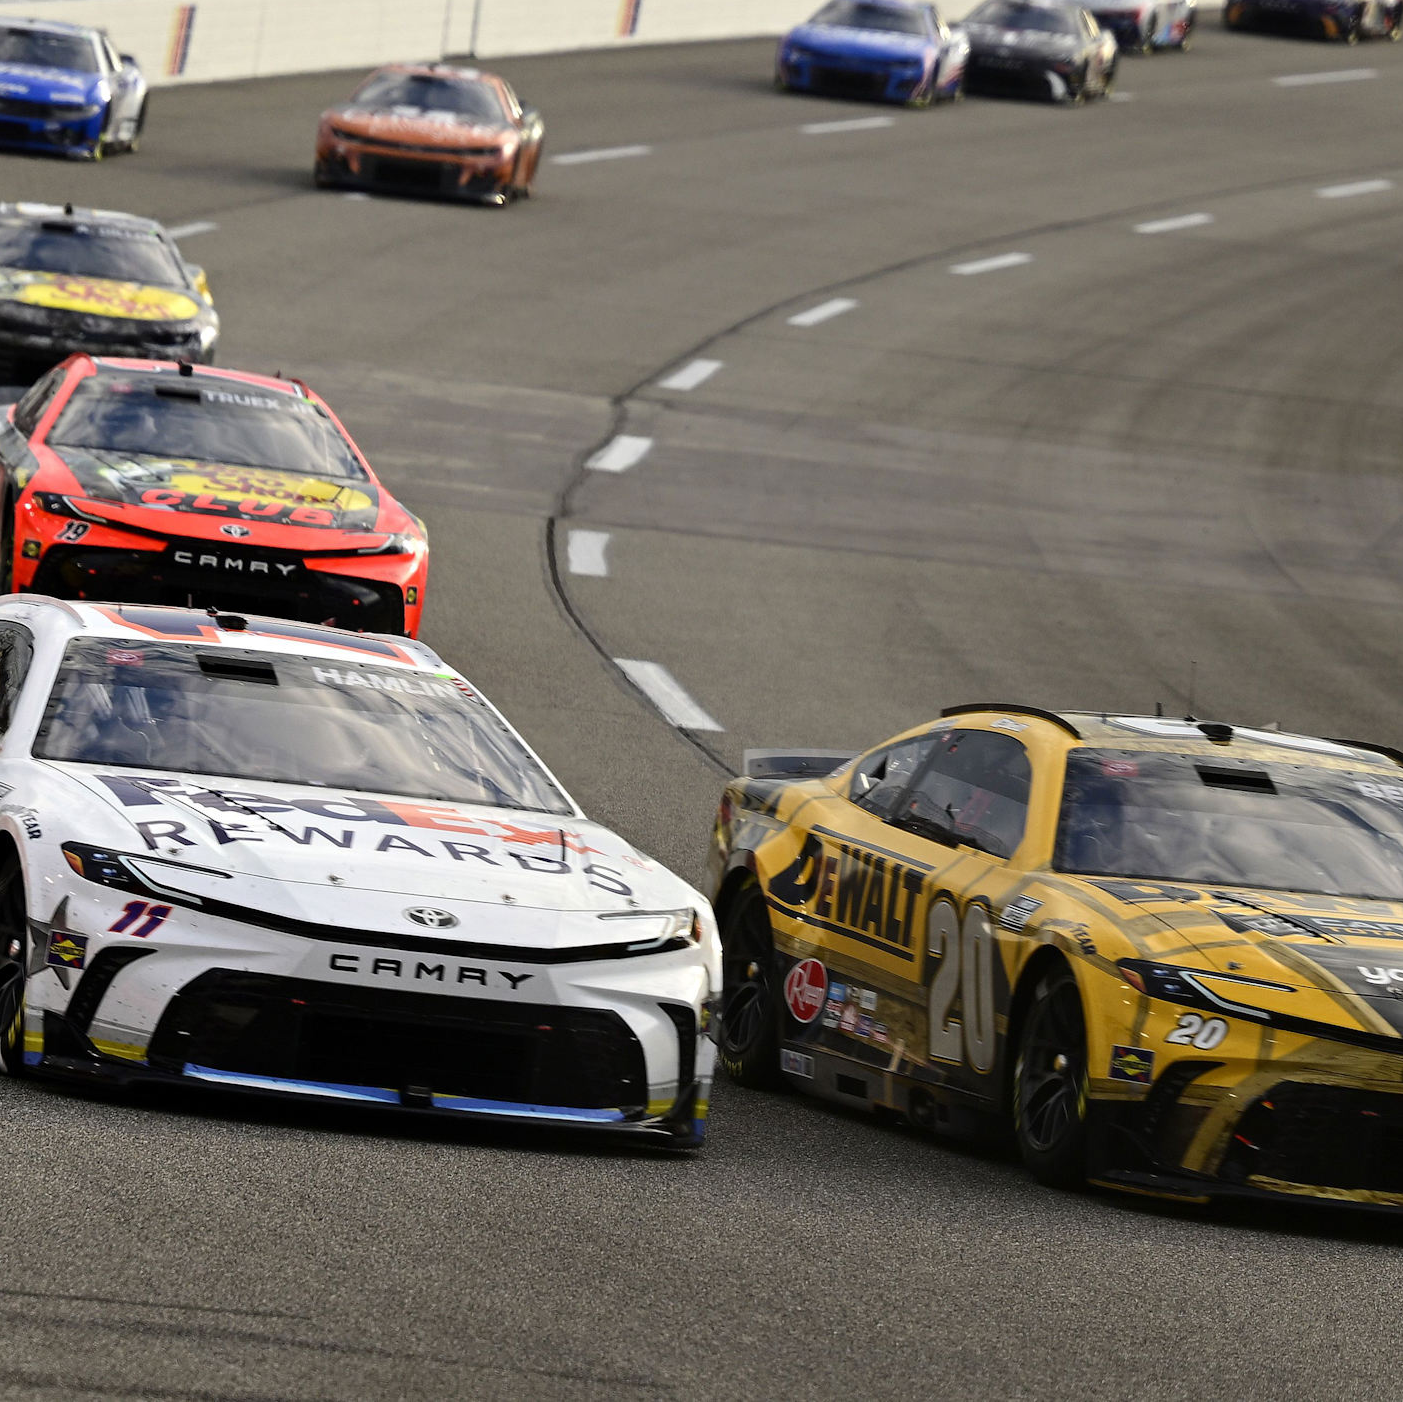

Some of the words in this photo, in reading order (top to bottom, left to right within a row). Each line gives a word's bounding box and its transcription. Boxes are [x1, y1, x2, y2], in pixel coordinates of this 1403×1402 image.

[202, 389, 280, 410] TRUEX
[141, 488, 335, 526] CLUB
[55, 520, 90, 543] 19
[174, 551, 297, 576] CAMRY
[311, 666, 464, 701] HAMLIN
[94, 774, 609, 857] FedEx
[135, 819, 634, 897] REWARDS
[107, 900, 174, 939] 11
[329, 953, 535, 991] CAMRY
[926, 895, 996, 1074] 20
[1164, 1012, 1231, 1051] 20
